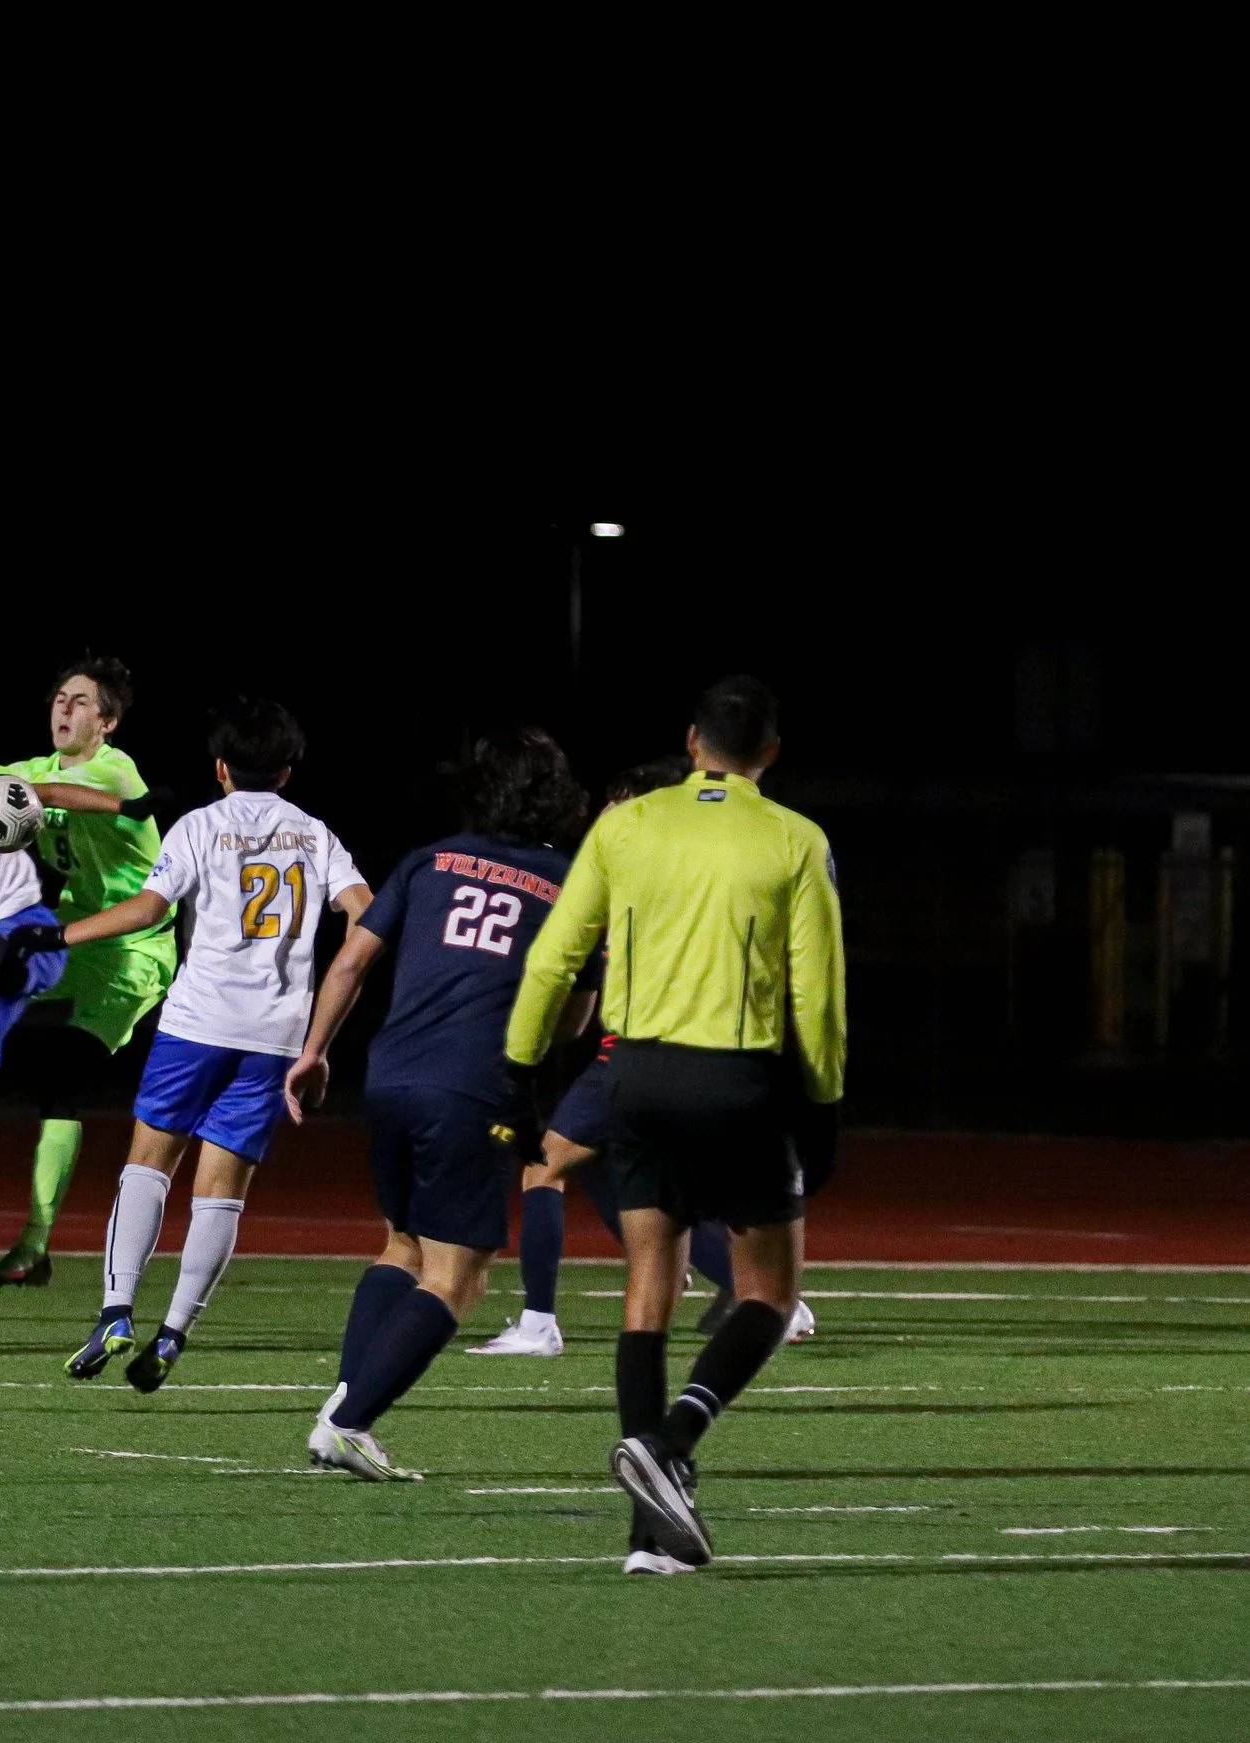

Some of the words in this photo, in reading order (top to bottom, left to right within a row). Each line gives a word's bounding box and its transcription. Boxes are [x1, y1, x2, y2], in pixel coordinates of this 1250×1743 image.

[240, 862, 305, 939] 21
[434, 851, 563, 905] WOLVERINES
[442, 885, 523, 956] 22
